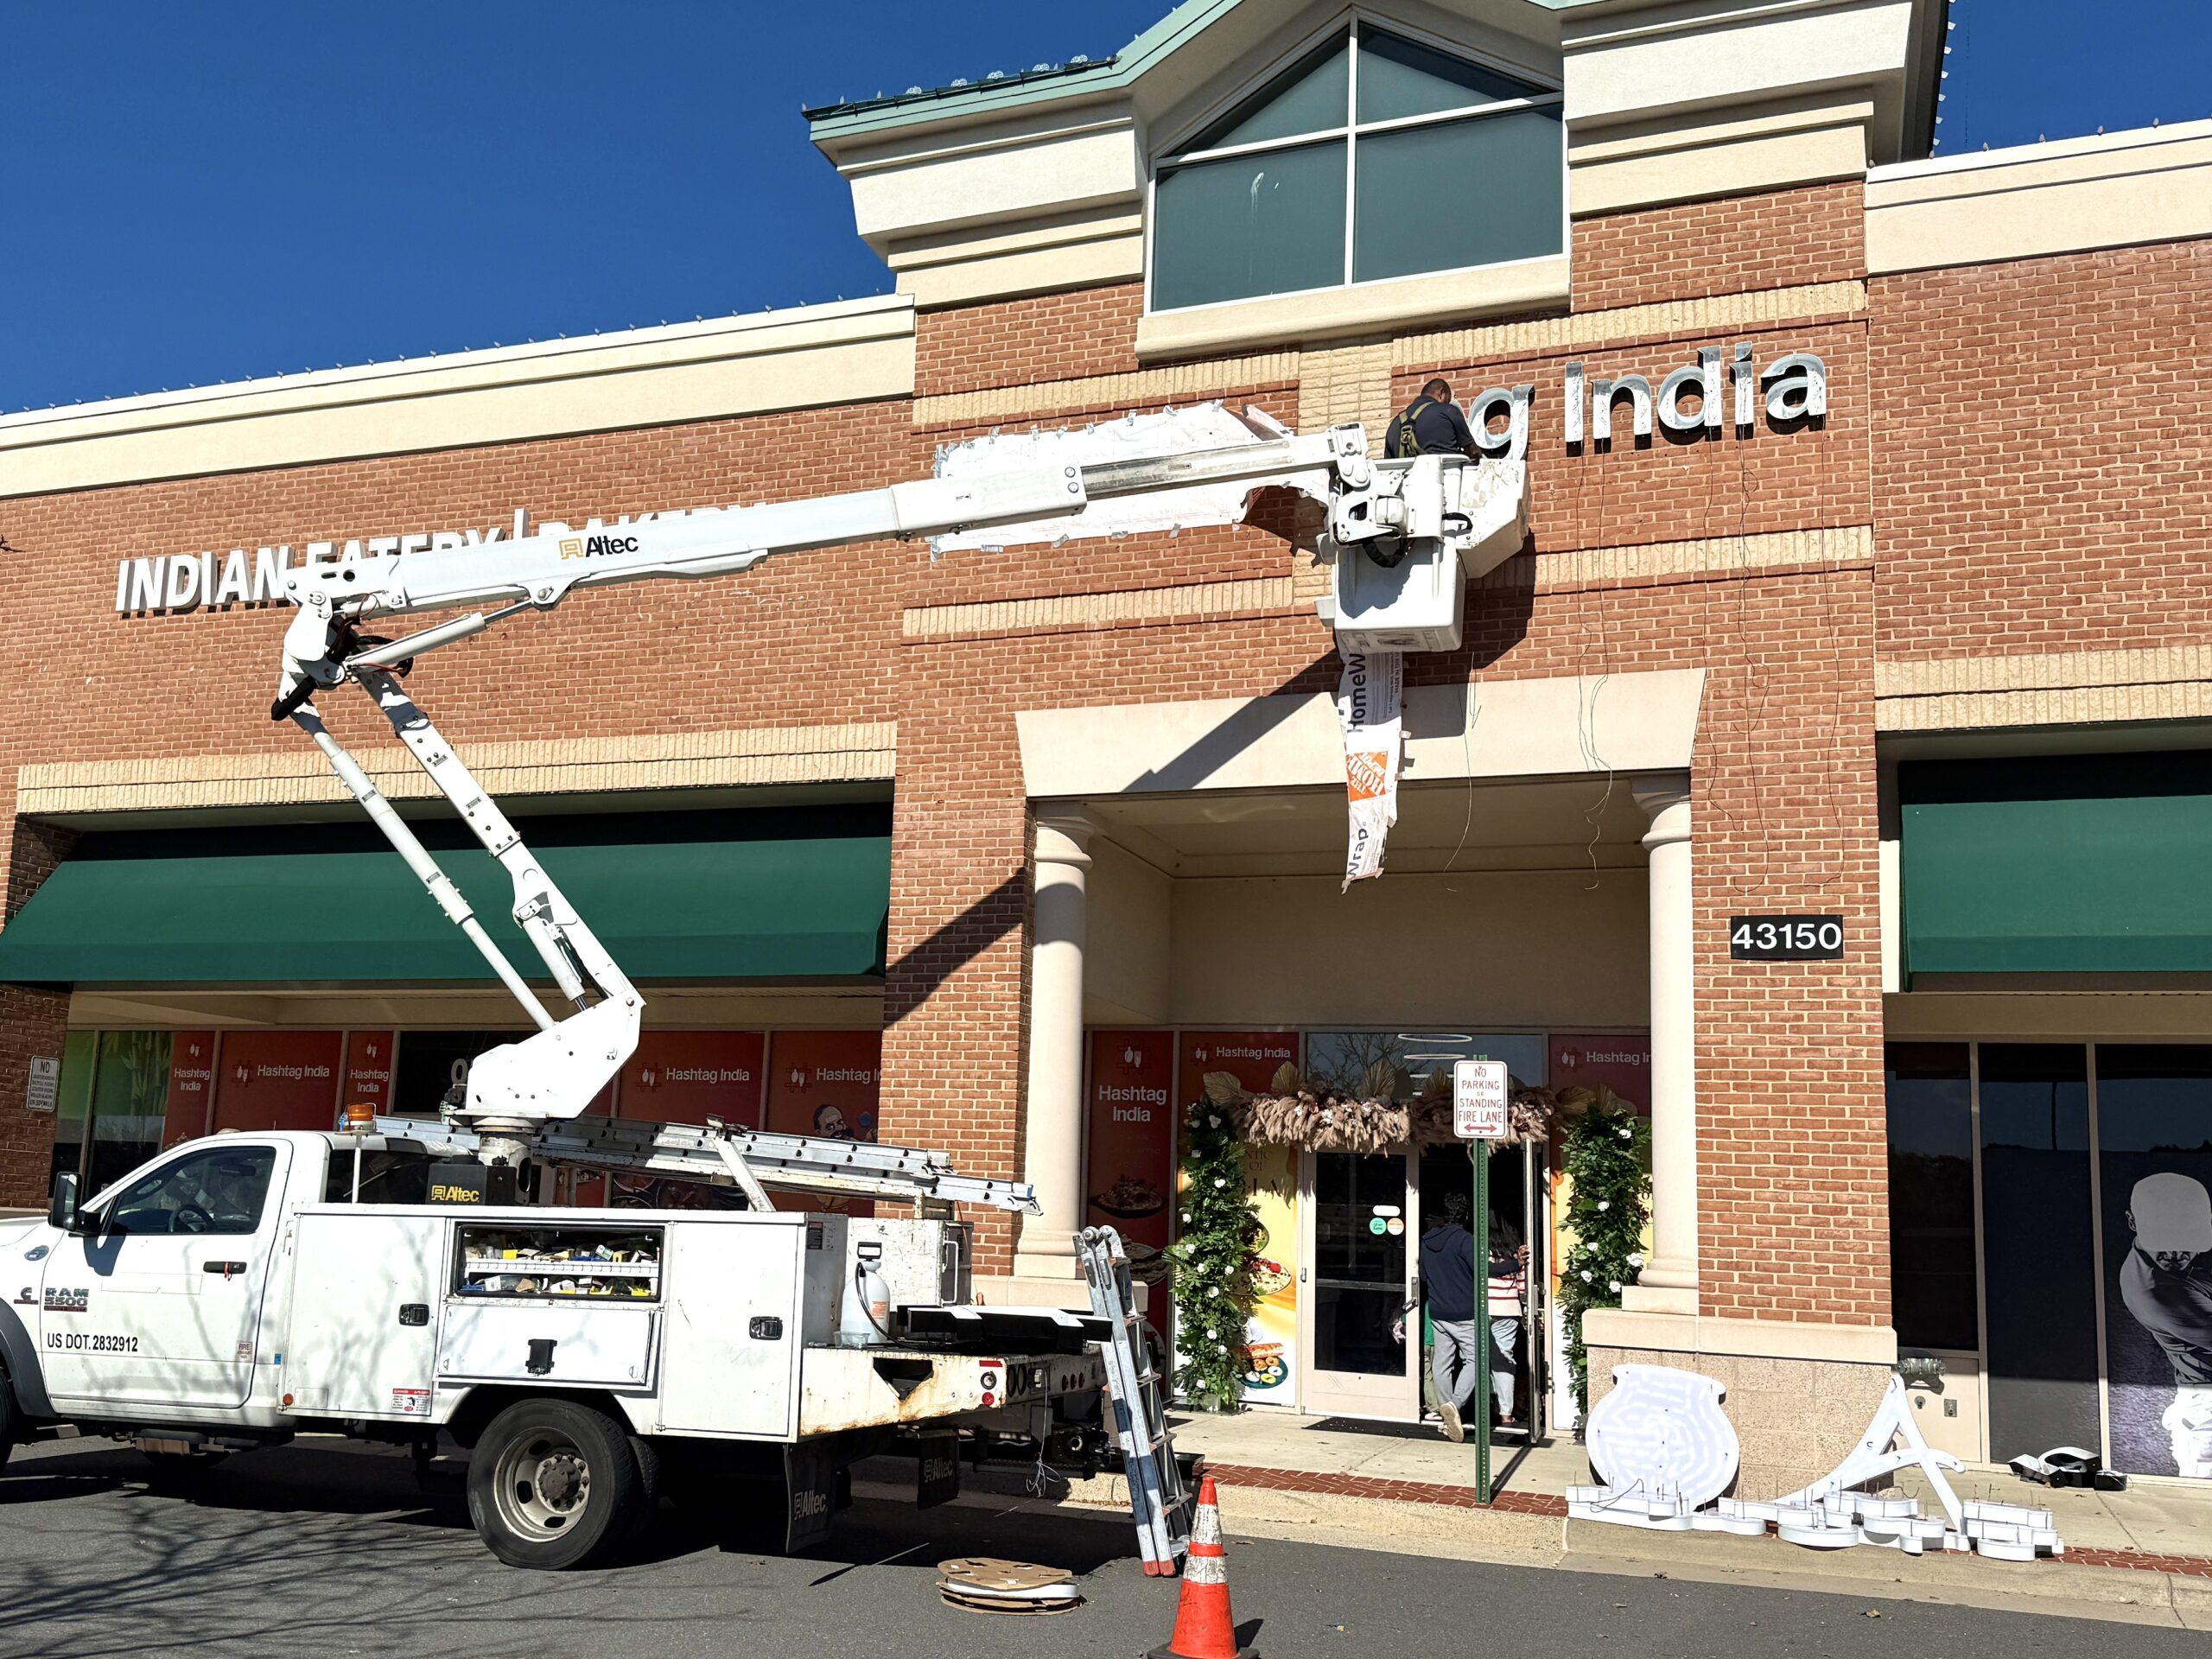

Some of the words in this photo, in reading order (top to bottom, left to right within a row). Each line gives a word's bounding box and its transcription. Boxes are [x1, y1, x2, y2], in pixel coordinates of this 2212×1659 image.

[1564, 341, 1827, 443] India
[586, 535, 639, 557] Altec
[115, 545, 289, 612] INDIAN
[1732, 923, 1842, 950] 43150
[1216, 1046, 1262, 1060] Hashtag
[1264, 1047, 1291, 1058] India
[1586, 1052, 1639, 1065] Hashtag
[174, 1068, 211, 1080] Hashtag
[257, 1065, 302, 1080] Hashtag
[304, 1065, 330, 1077] India
[350, 1069, 389, 1082] Hashtag
[666, 1067, 718, 1084] Hashtag
[720, 1068, 750, 1081] India
[817, 1068, 870, 1084] Hashtag
[1474, 1068, 1486, 1077] NO
[181, 1081, 201, 1091] India
[358, 1083, 379, 1093] India
[1462, 1080, 1499, 1090] PARKING
[1098, 1085, 1166, 1106] Hashtag
[1459, 1098, 1502, 1108] STANDING
[1113, 1106, 1151, 1122] India
[1459, 1110, 1477, 1122] FIRE
[1480, 1111, 1503, 1122] LANE
[445, 1186, 480, 1202] Altec
[46, 1287, 89, 1297] RAM
[44, 1297, 88, 1306] 5500
[48, 1333, 62, 1348] US
[932, 1458, 952, 1479] Altec
[802, 1490, 826, 1516] Altec
